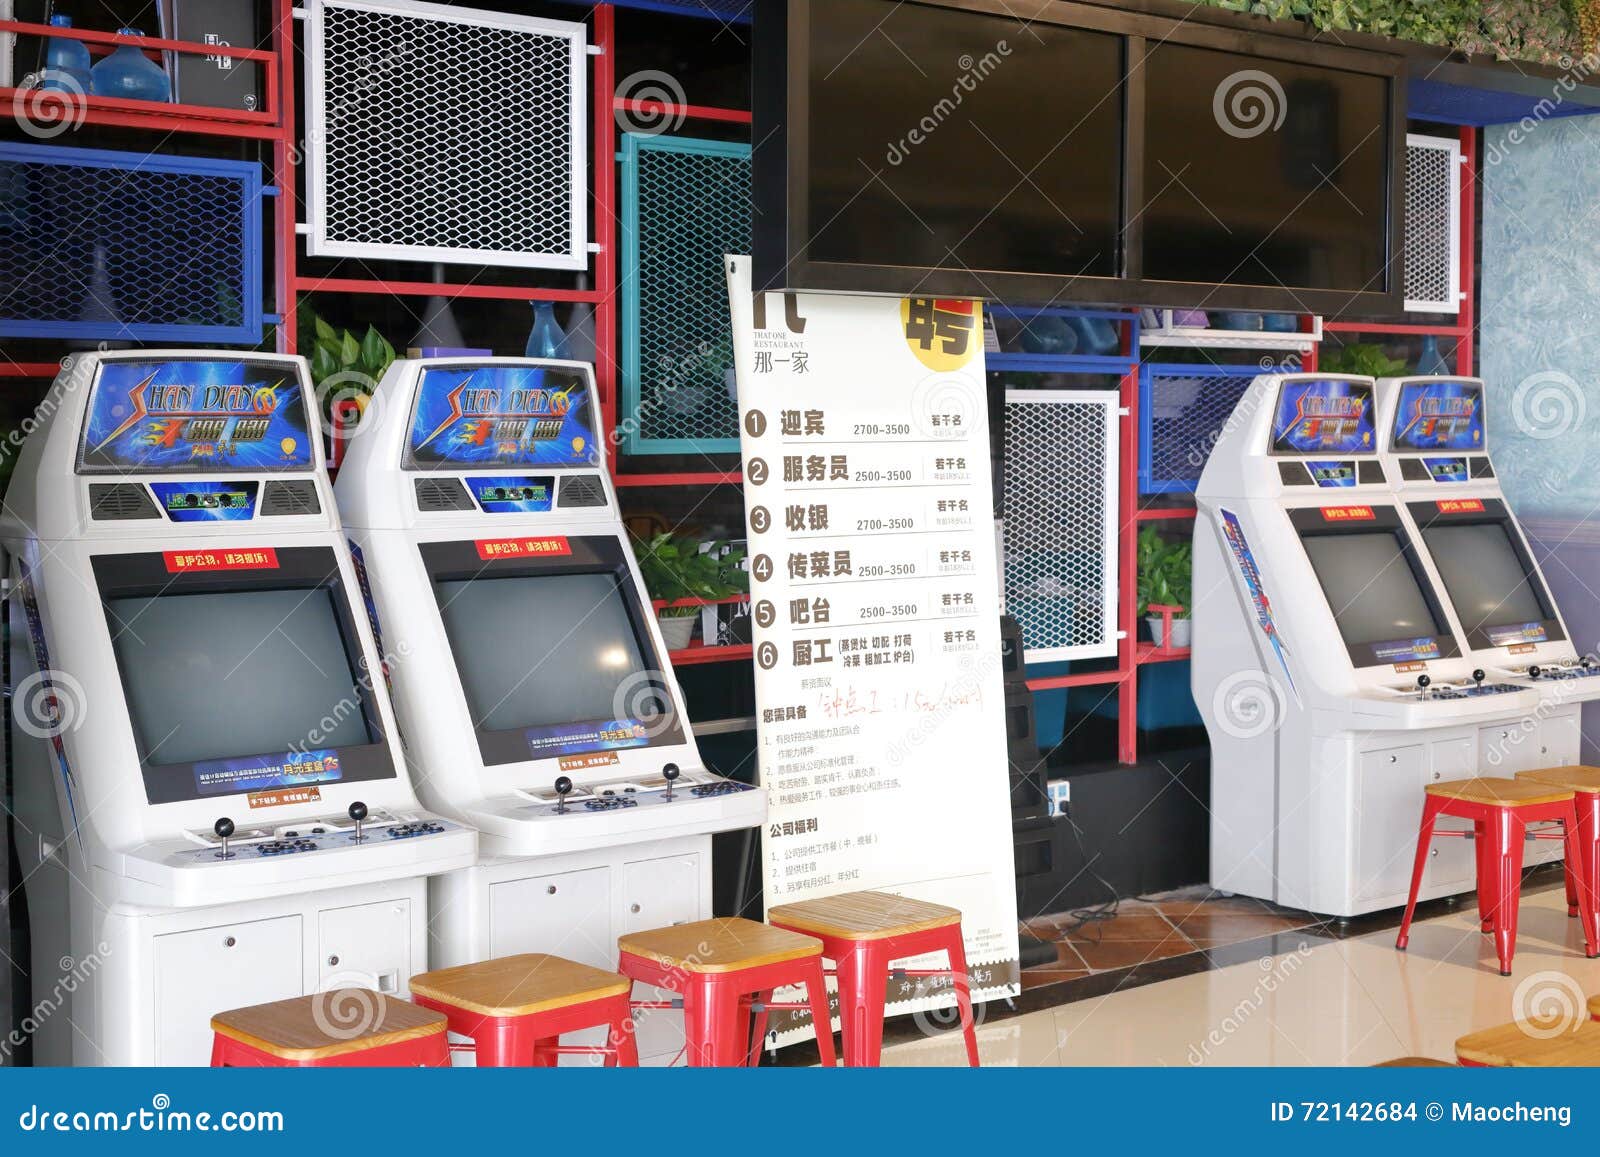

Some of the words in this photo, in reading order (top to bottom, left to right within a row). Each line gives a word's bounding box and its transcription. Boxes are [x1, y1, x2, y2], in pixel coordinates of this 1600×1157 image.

[753, 350, 809, 373] 那一家
[781, 409, 825, 436] 迎宾
[854, 424, 910, 435] 2700-3500
[931, 414, 962, 426] 若干名
[783, 455, 849, 482] 服务员
[855, 470, 912, 481] 2500-3500
[935, 458, 966, 470] 若干名
[785, 504, 829, 531] 收银
[857, 518, 914, 530] 2700-3500
[936, 500, 968, 512] 若干名
[787, 550, 853, 580] 传菜员
[858, 564, 916, 577] 2500-3500
[939, 550, 971, 563] 若干名
[789, 597, 831, 625] 吧台
[859, 605, 917, 619] 2500-3500
[941, 593, 974, 606] 若干名
[792, 638, 833, 667] 厨工
[943, 629, 976, 643] 若干名
[763, 705, 808, 723] 您需具备
[770, 817, 818, 838] 公司福利
